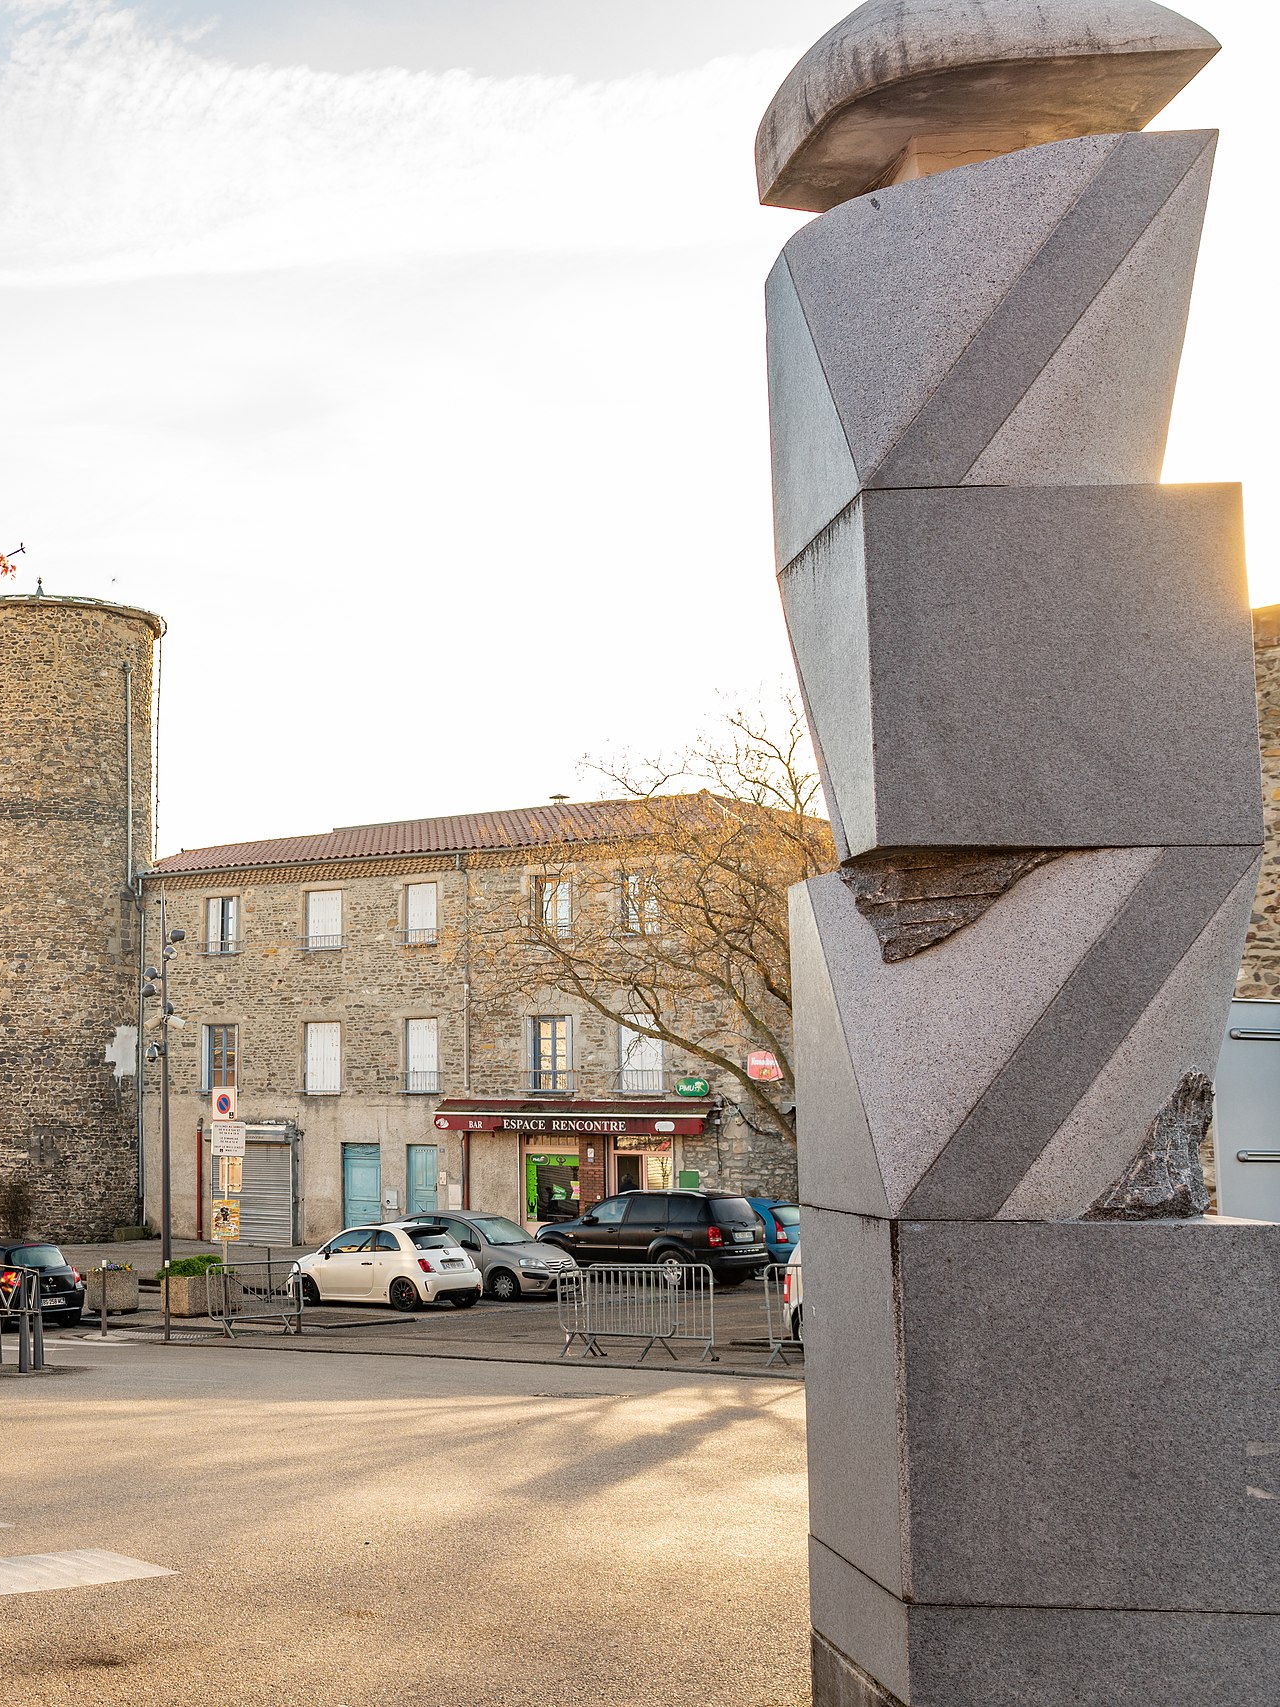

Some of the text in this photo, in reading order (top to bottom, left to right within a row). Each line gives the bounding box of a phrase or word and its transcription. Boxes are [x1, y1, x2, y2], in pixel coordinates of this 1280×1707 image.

[678, 1084, 695, 1092] PMU
[468, 1120, 483, 1129] BAR
[503, 1119, 627, 1132] ESPACE RENCONTRE
